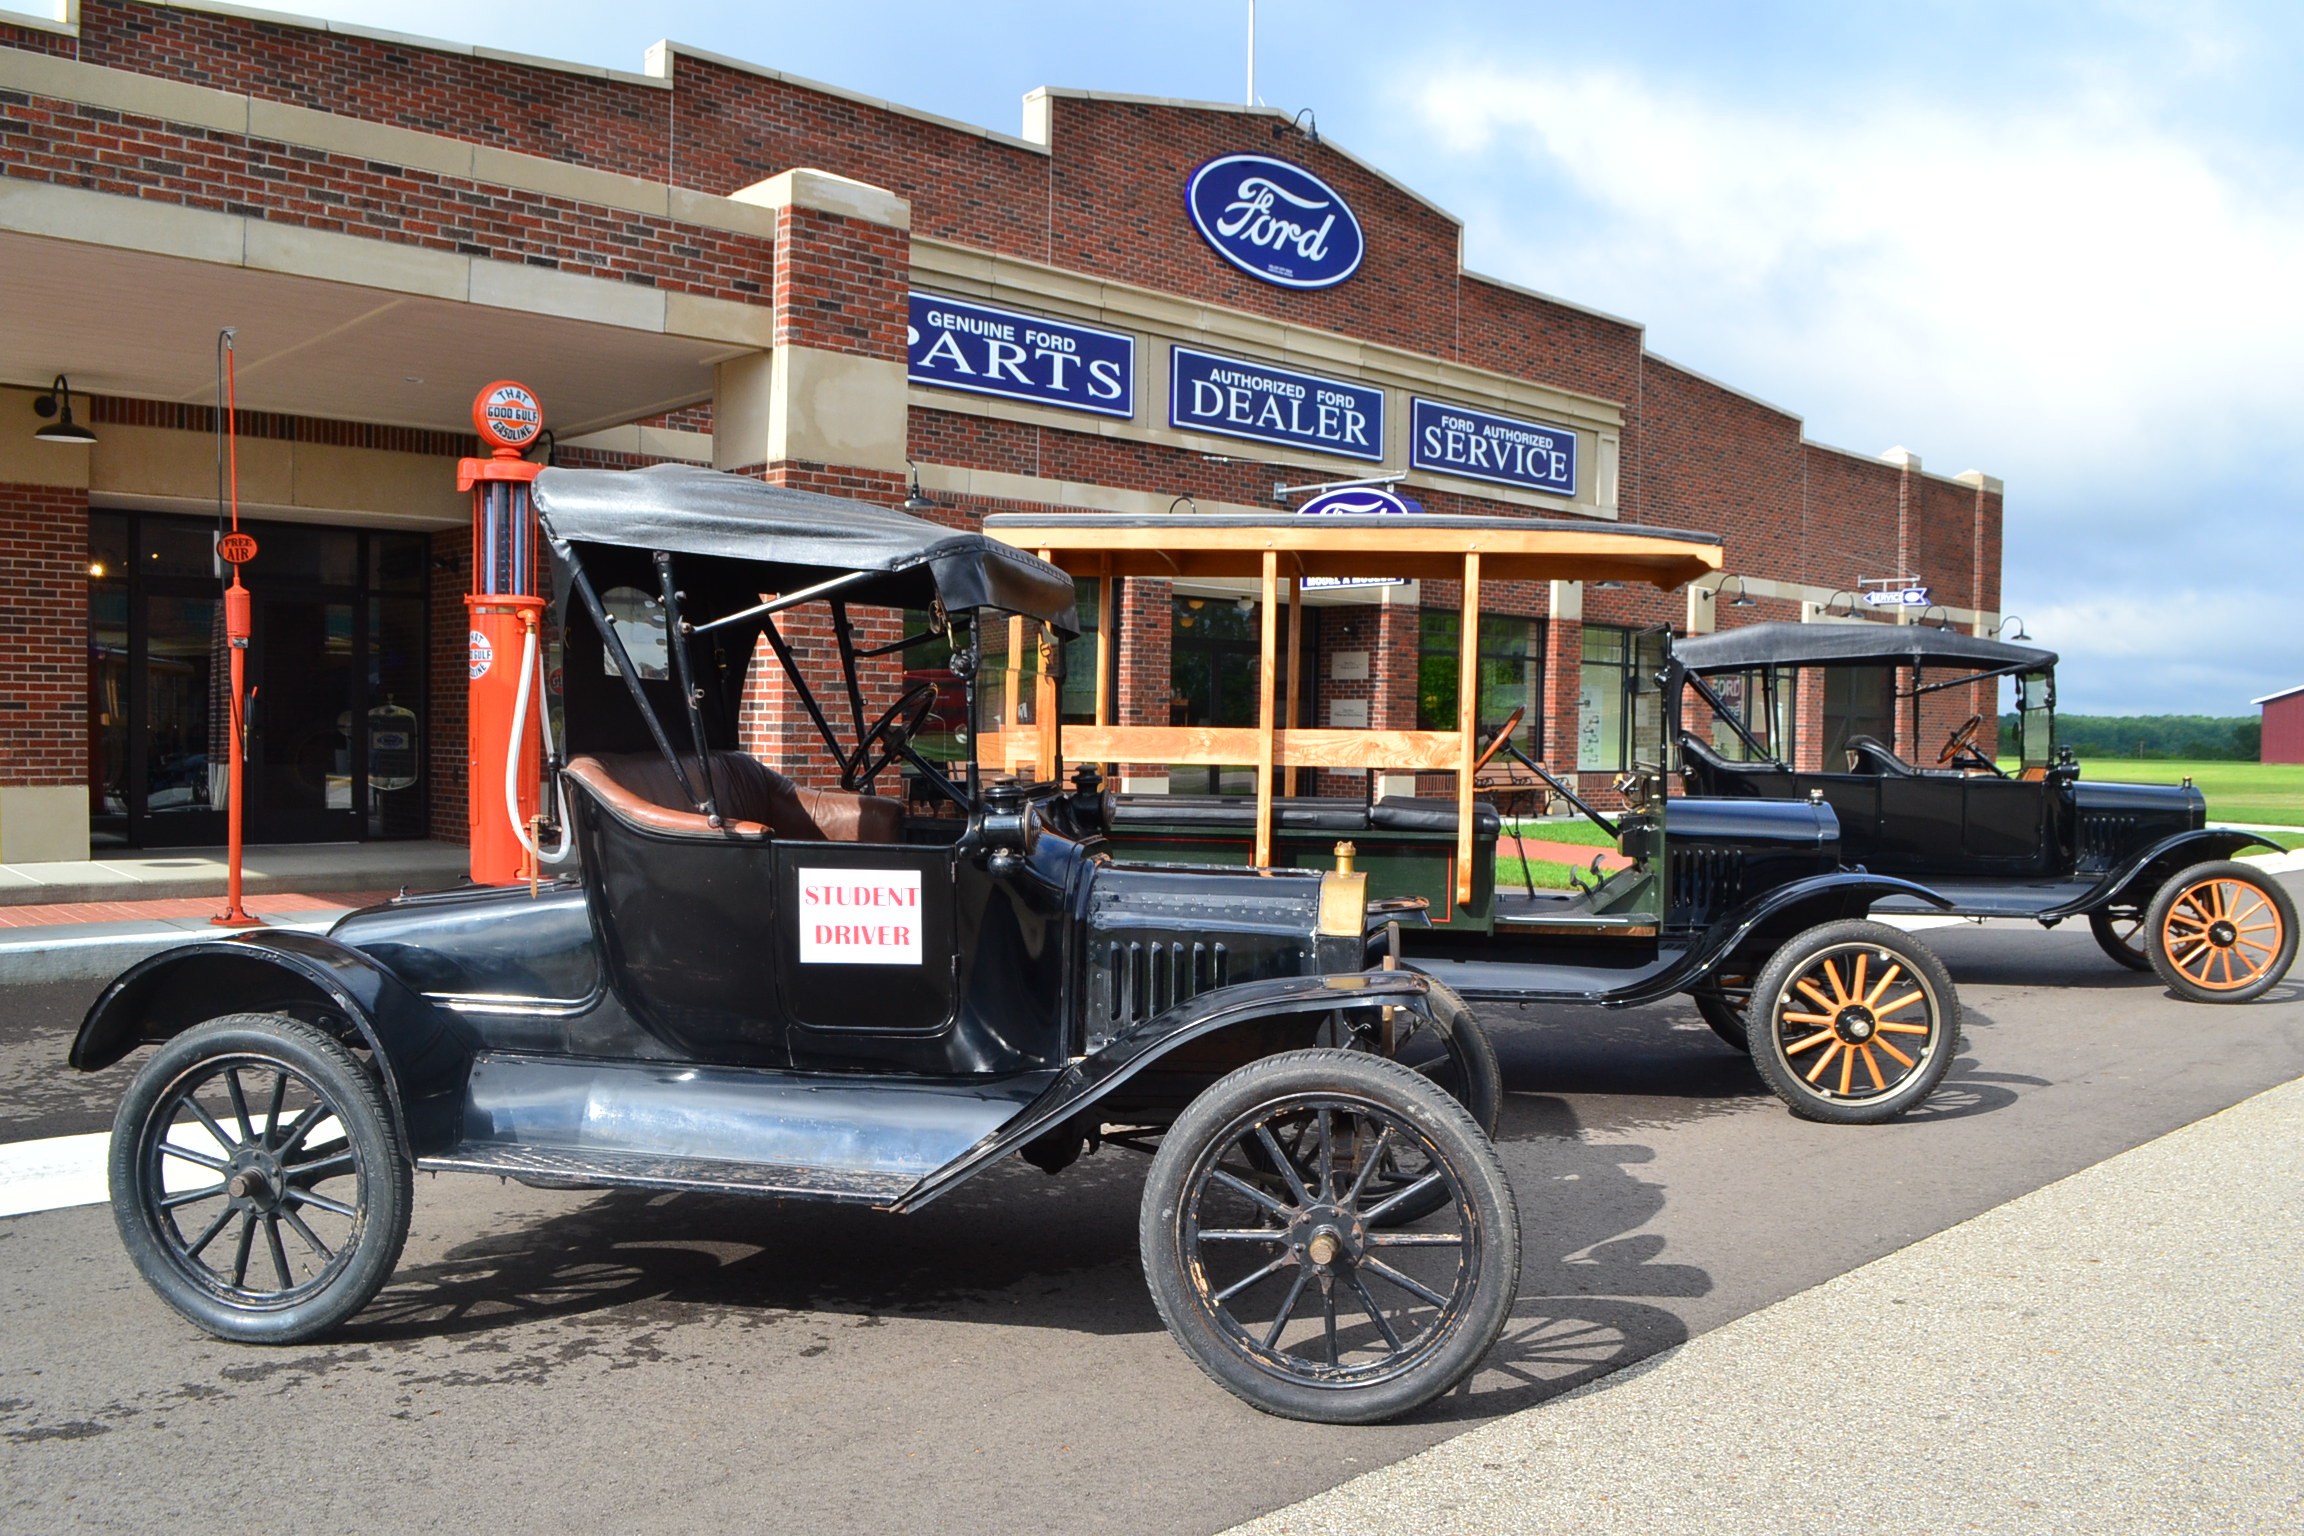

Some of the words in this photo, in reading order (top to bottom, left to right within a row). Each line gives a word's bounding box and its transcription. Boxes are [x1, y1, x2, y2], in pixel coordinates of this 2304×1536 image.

[1217, 177, 1335, 261] Ford
[927, 310, 1015, 341] GENUINE
[1025, 330, 1076, 353] FORD
[496, 388, 529, 402] THAT
[1210, 368, 1305, 399] AUTHORIZED
[1317, 390, 1355, 409] FORD
[487, 406, 513, 419] GOOD
[515, 409, 538, 422] GULF
[1191, 379, 1369, 446] DEALER
[493, 420, 532, 440] GASOLINE
[1442, 415, 1474, 433] FORD
[1483, 424, 1553, 449] AUTHORIZED
[1424, 426, 1568, 482] SERVICE
[225, 538, 252, 547] FREE
[227, 547, 249, 561] AIR
[471, 632, 484, 643] HAT
[474, 650, 491, 660] GULF
[470, 663, 487, 678] OLINE
[1713, 679, 1740, 697] FORD
[805, 886, 919, 907] STUDENT
[815, 925, 910, 945] DRIVER
